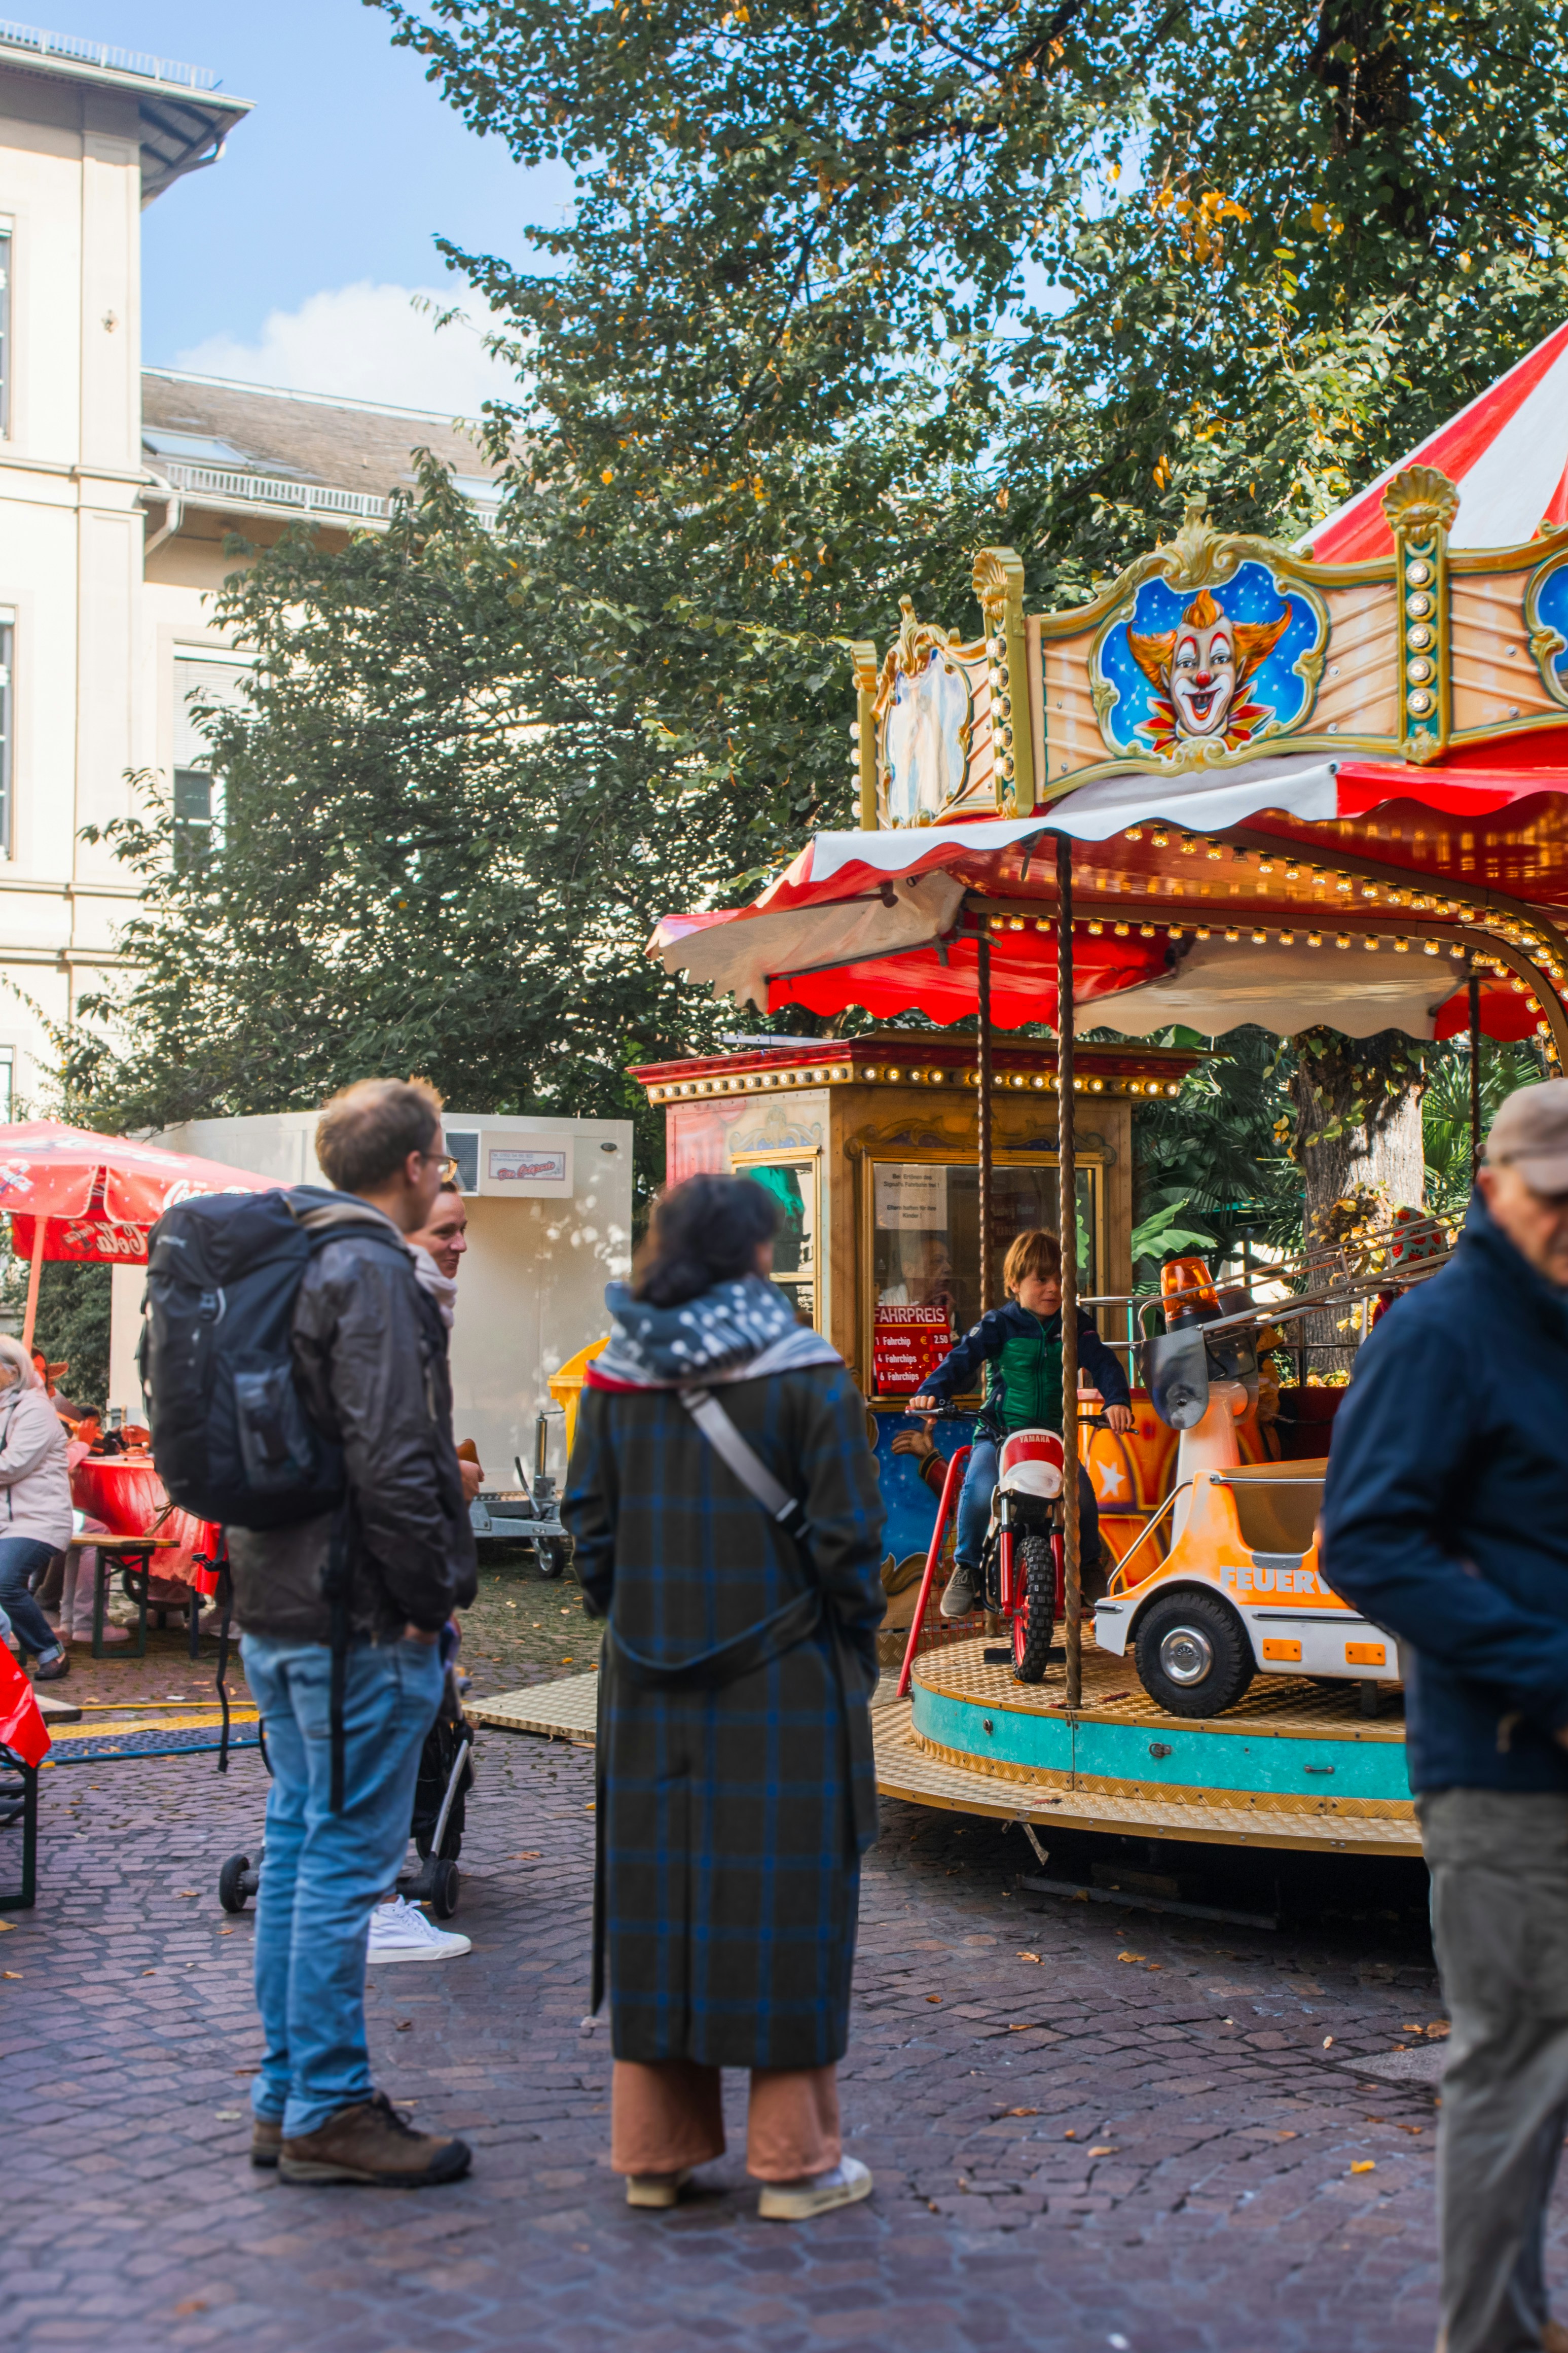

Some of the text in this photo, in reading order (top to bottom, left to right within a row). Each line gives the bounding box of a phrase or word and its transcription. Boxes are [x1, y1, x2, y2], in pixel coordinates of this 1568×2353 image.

[874, 1307, 945, 1323] FAHRPREIS
[883, 1336, 911, 1347] Fahrchip
[934, 1335, 948, 1344] 2.50
[878, 1353, 883, 1363] 4
[885, 1353, 917, 1365] Fahrchips
[880, 1372, 885, 1381] 6
[887, 1371, 920, 1382] Fahrchips
[1019, 1435, 1050, 1443] YAMAHA
